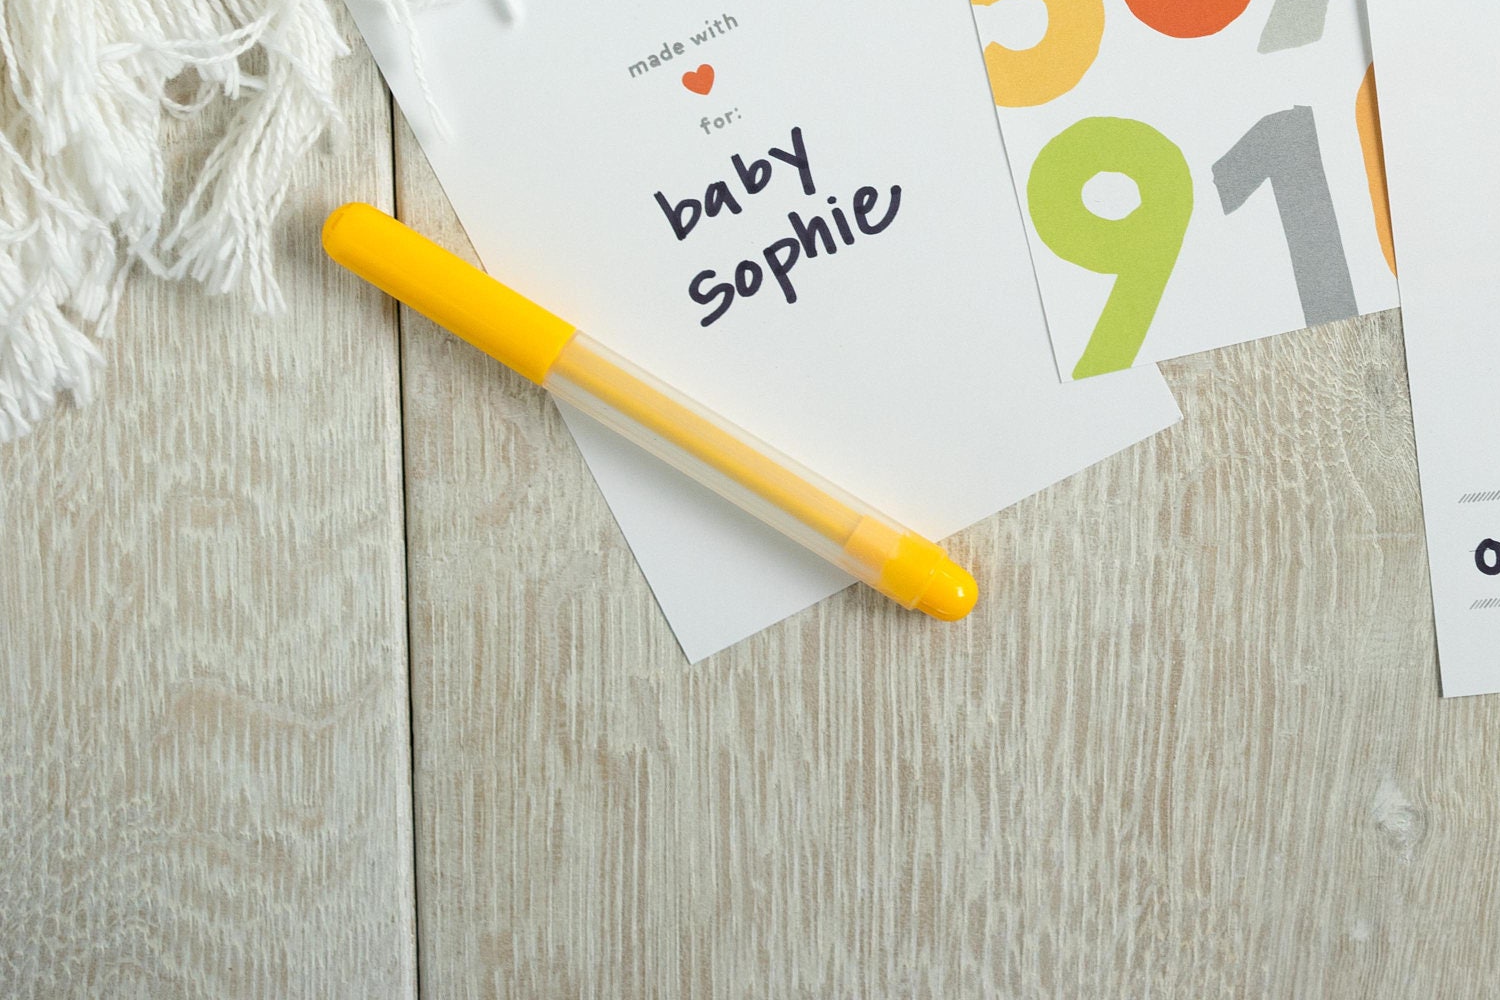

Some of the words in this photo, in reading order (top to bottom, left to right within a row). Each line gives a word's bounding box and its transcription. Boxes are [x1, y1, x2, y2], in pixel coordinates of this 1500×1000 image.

[628, 42, 685, 79] made
[690, 13, 739, 47] with
[699, 107, 743, 135] for:
[654, 126, 816, 241] baby
[688, 185, 902, 328] sophie
